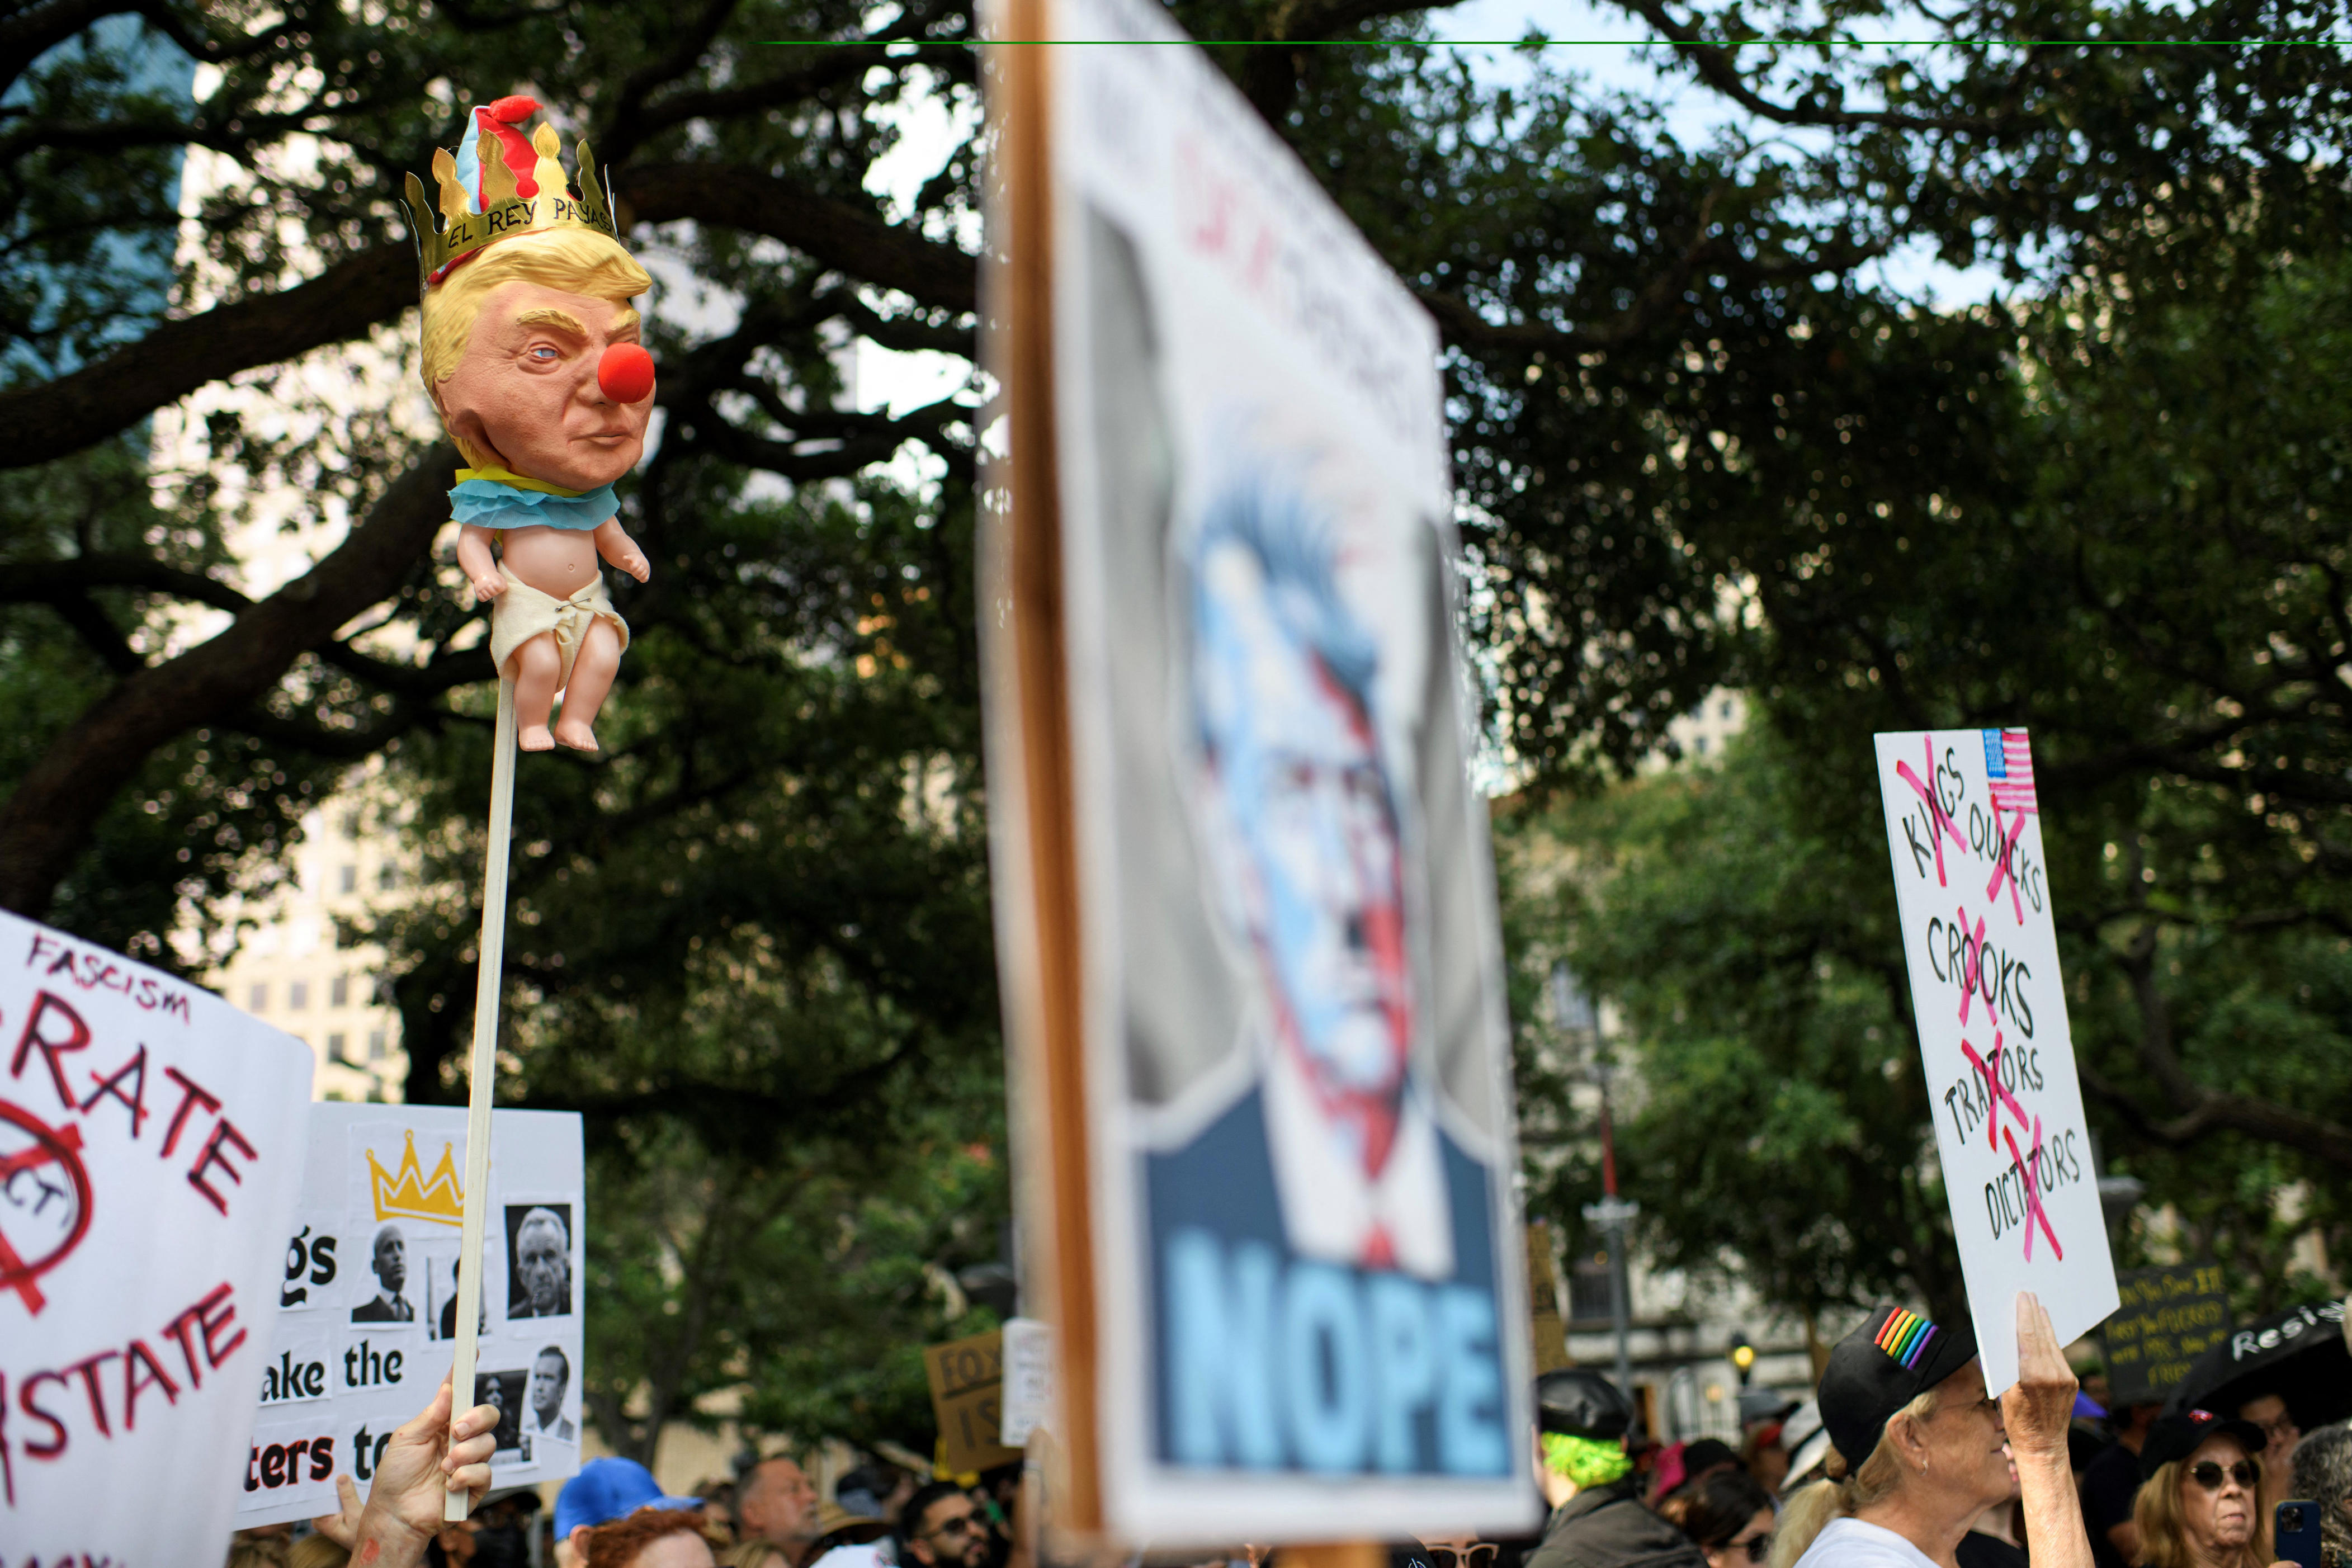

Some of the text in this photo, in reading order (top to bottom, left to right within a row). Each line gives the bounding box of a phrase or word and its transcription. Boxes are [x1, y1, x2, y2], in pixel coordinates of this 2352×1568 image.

[448, 197, 613, 249] EL REY PAYAS
[1902, 746, 1964, 879] KINGS
[1970, 802, 2042, 914] QUACKS
[27, 930, 190, 1026] FASCISM
[1927, 917, 2033, 1039] CROOKS
[0, 989, 258, 1217] RATE
[1944, 1045, 2044, 1145] TRAITORS
[1985, 1127, 2080, 1241] DICTATORS
[0, 1279, 248, 1508] STATE
[343, 1338, 403, 1388] the
[1166, 1225, 1510, 1475] NOPE
